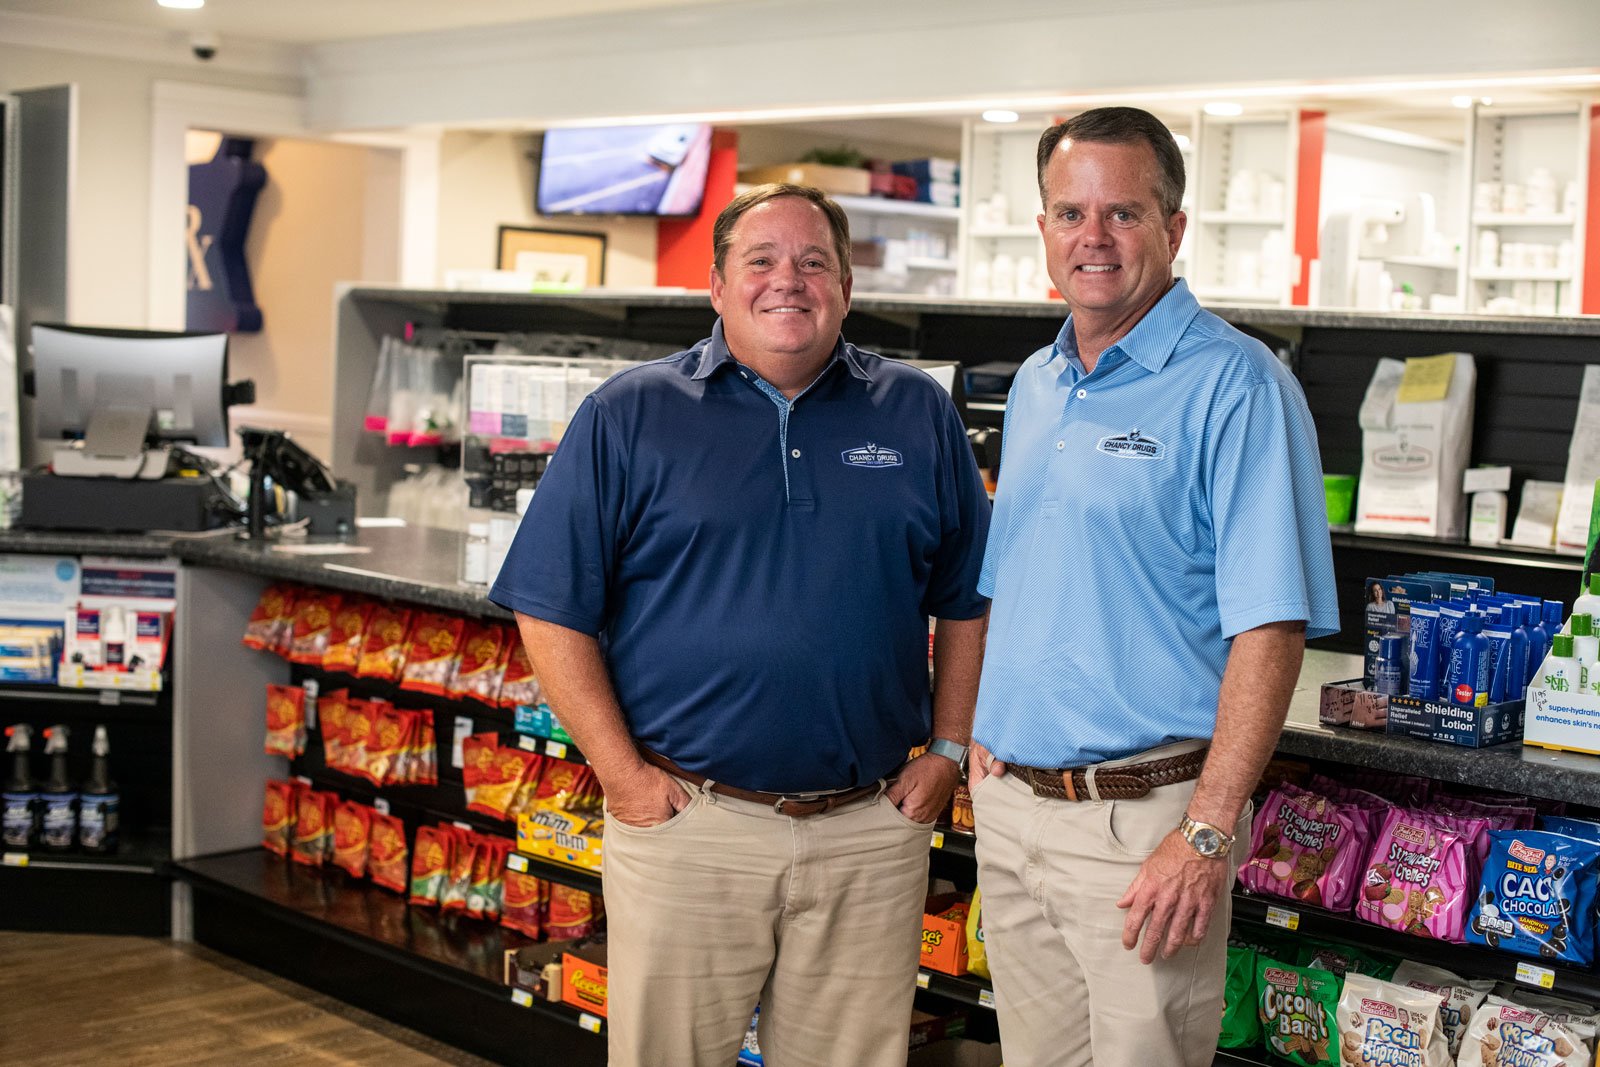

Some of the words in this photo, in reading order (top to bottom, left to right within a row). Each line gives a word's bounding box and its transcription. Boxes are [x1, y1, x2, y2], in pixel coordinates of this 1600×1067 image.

[1104, 441, 1131, 450] CHANCY
[1132, 444, 1157, 454] DRUGS
[848, 454, 875, 462] CHANCY
[876, 454, 898, 462] DRUGS
[1456, 689, 1473, 698] Tester
[1424, 703, 1474, 722] Shielding
[1548, 704, 1600, 718] super-hydratin
[1441, 718, 1473, 733] Lotion
[1536, 715, 1571, 727] enhances
[1572, 717, 1593, 730] skin's
[1278, 803, 1341, 841] Strawberry
[1283, 823, 1325, 851] Cremes
[1389, 843, 1441, 873] Strawberr
[1506, 860, 1523, 871] BITE
[1395, 863, 1430, 887] Cremes
[1519, 916, 1550, 930] SANDWICH
[921, 930, 943, 946] se's
[1263, 984, 1330, 1039] Coconut
[1280, 1013, 1317, 1042] Bars
[1367, 1018, 1421, 1050] Pecan
[1361, 1040, 1420, 1067] Supremes
